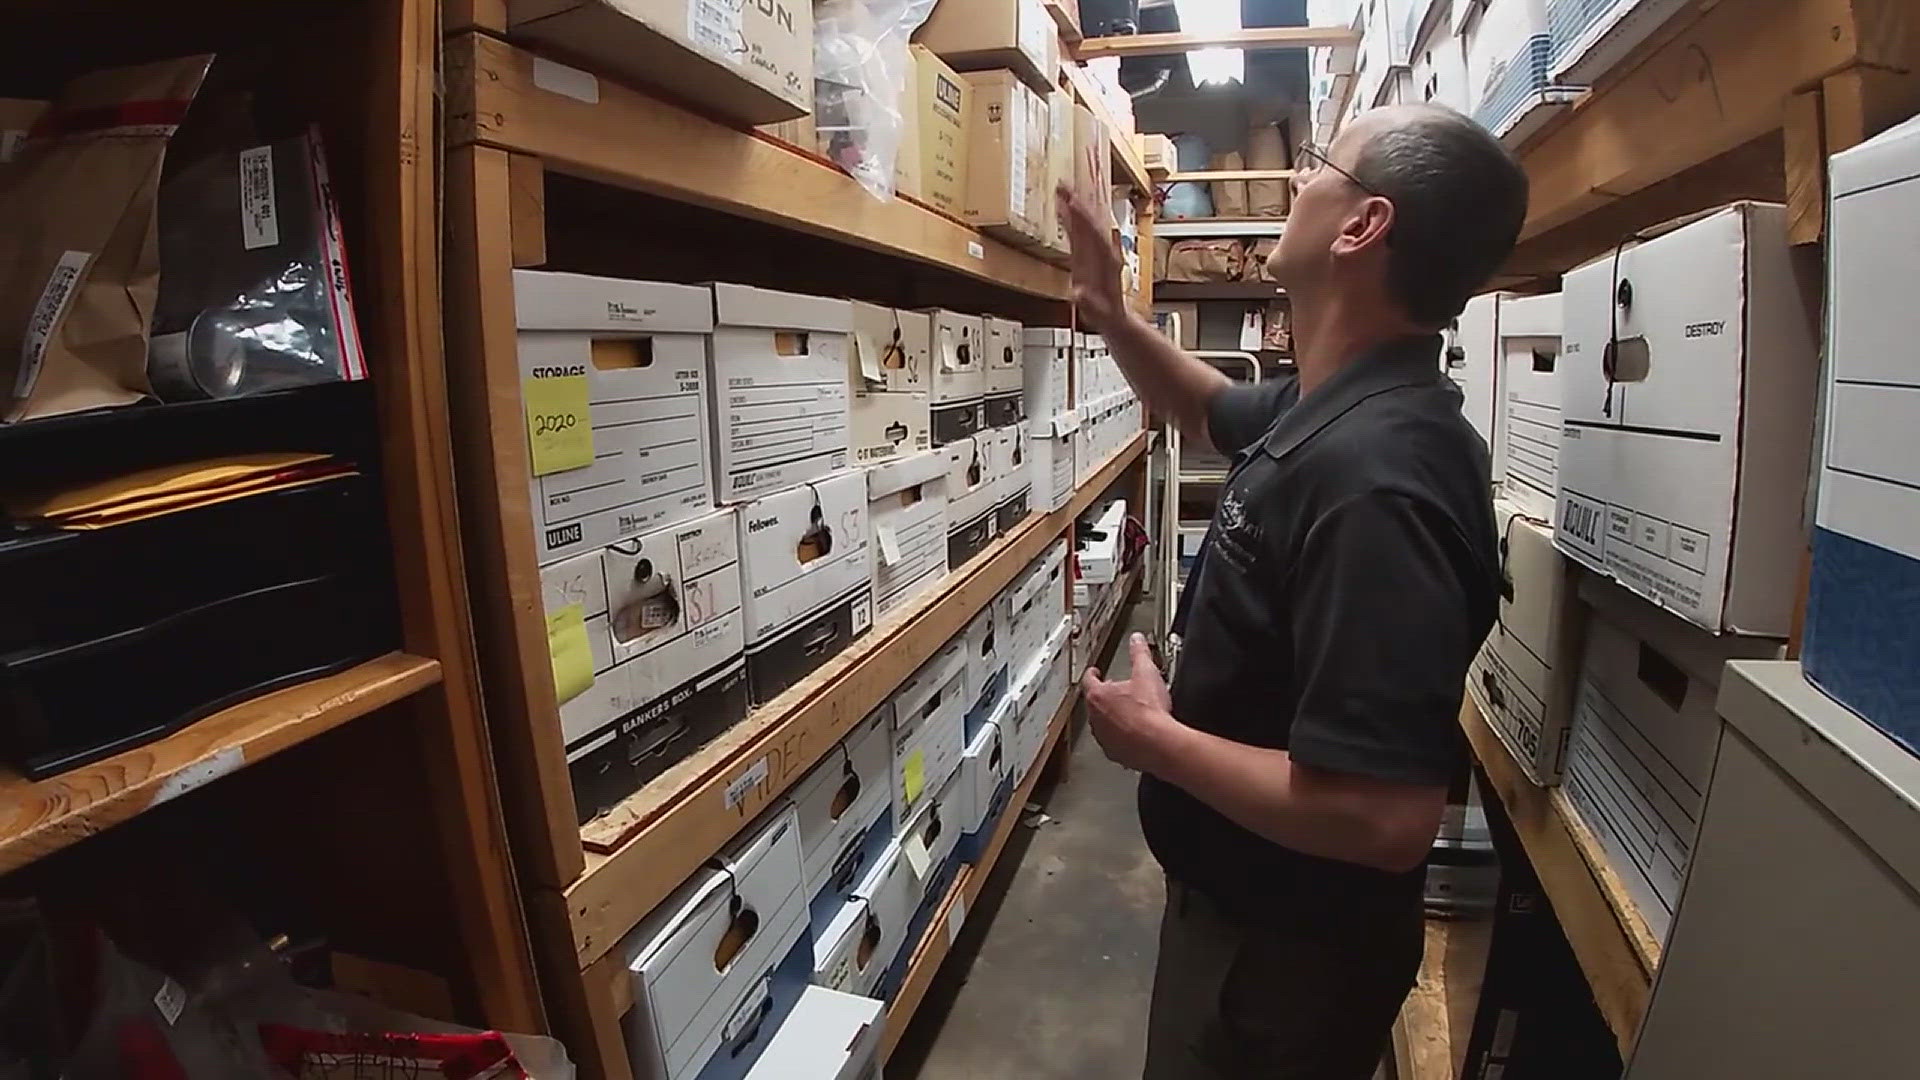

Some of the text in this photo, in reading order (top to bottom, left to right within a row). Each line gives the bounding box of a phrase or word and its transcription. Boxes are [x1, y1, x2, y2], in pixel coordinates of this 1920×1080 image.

[747, 0, 793, 34] ON
[1685, 321, 1726, 338] DESTROY
[535, 413, 577, 437] 2020
[549, 526, 581, 547] ULINE
[857, 607, 867, 627] 12
[622, 687, 690, 734] BANKERS BOX
[1517, 717, 1538, 758] 705
